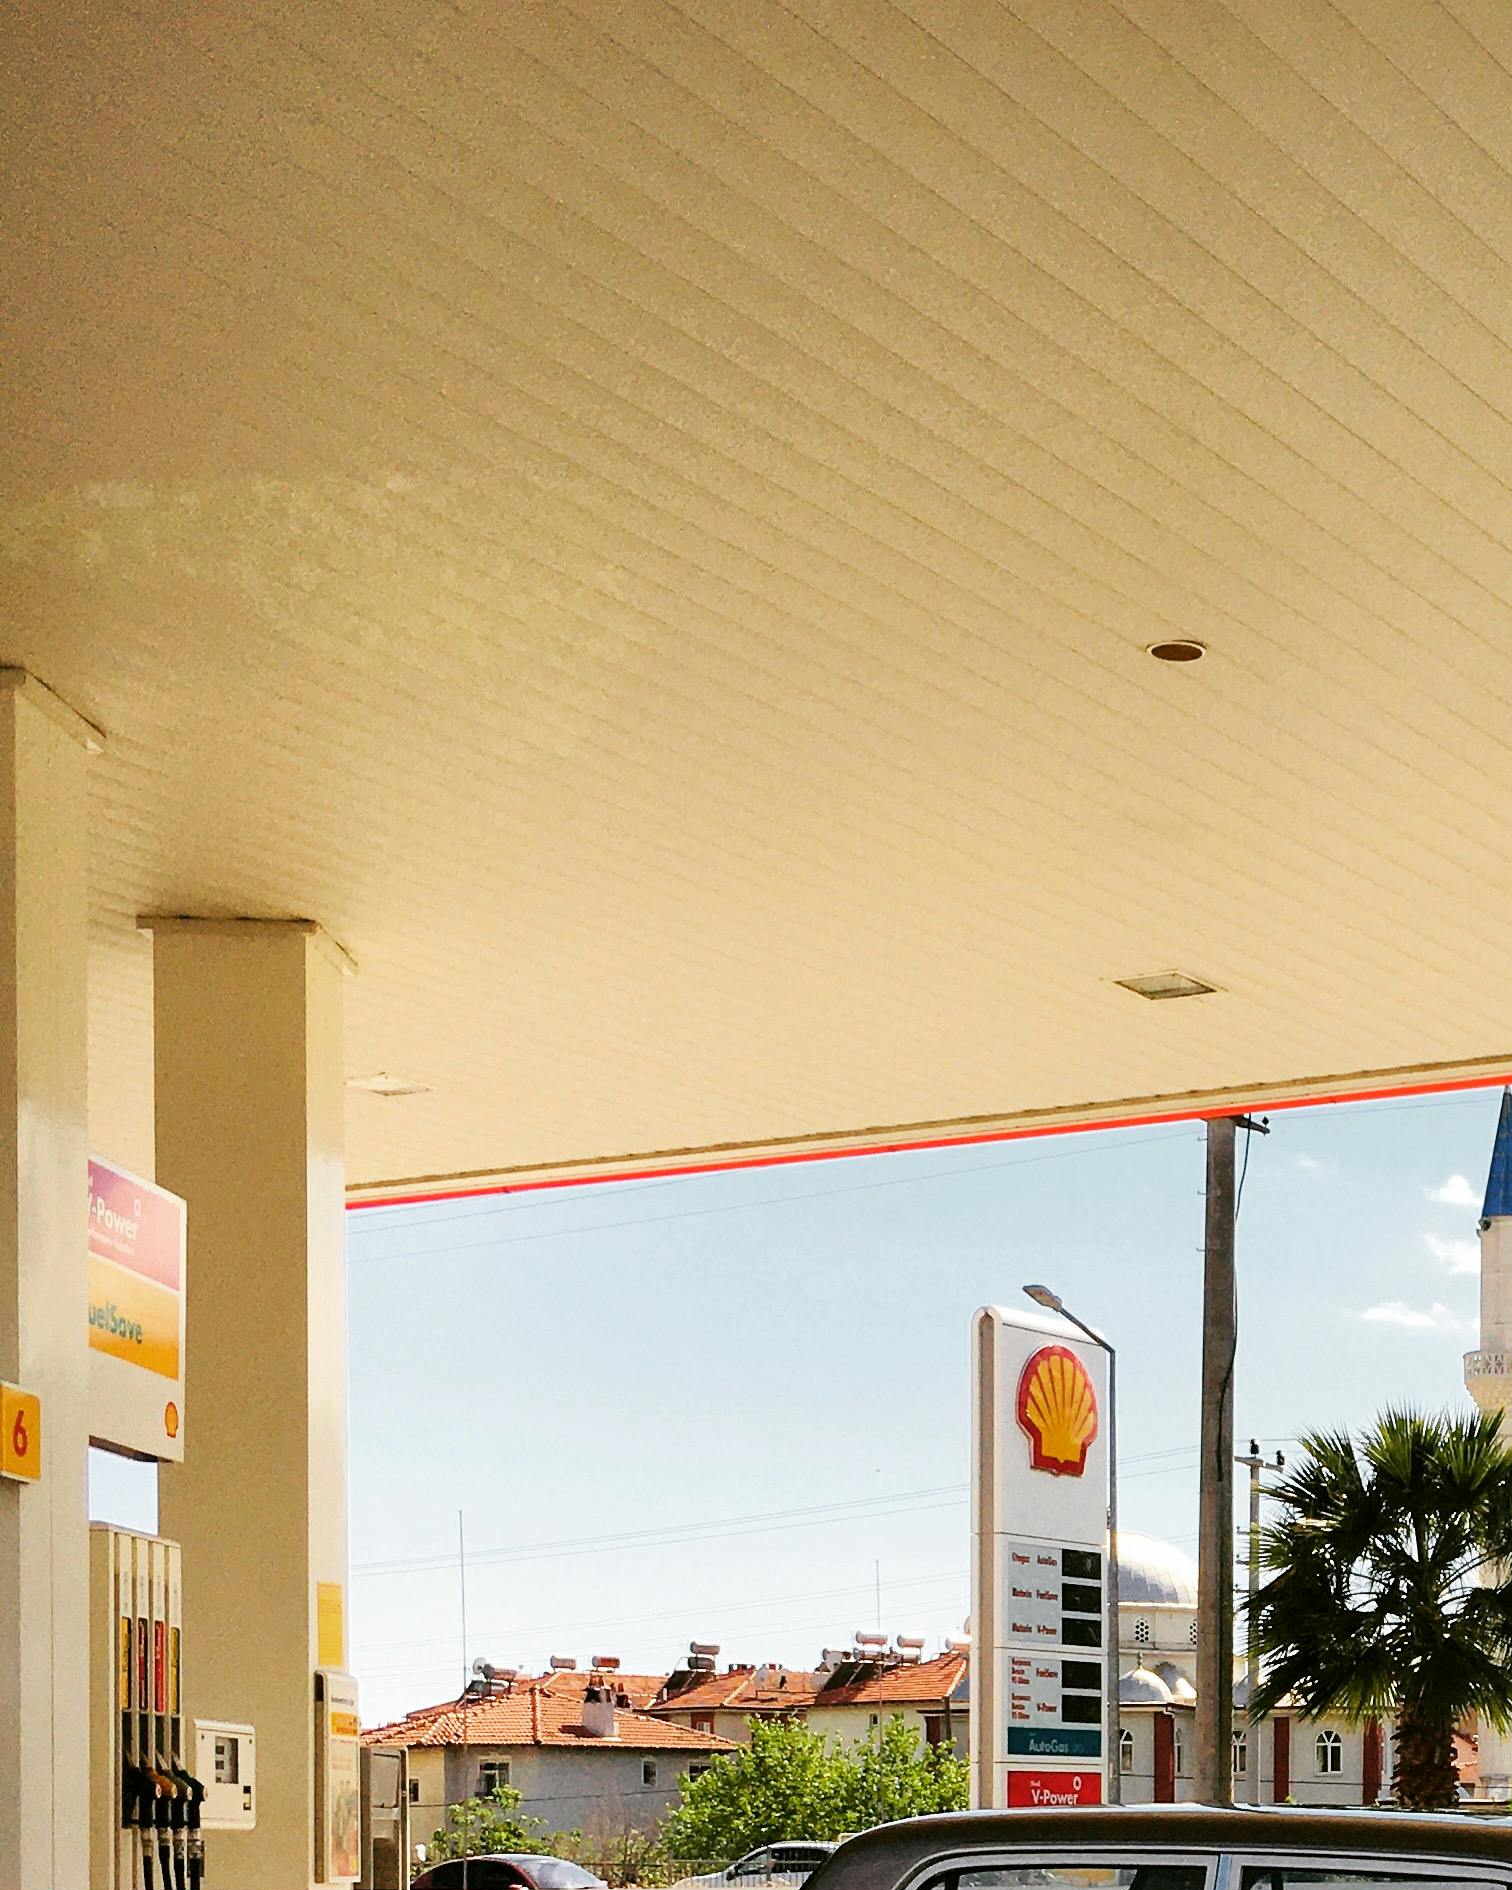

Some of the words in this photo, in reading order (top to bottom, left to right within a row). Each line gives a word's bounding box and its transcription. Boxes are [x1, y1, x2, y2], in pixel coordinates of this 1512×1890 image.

[88, 1301, 143, 1344] uelSave
[13, 1409, 28, 1457] 6
[1029, 1738, 1069, 1753] AutoGas
[1031, 1788, 1079, 1806] V-Power
